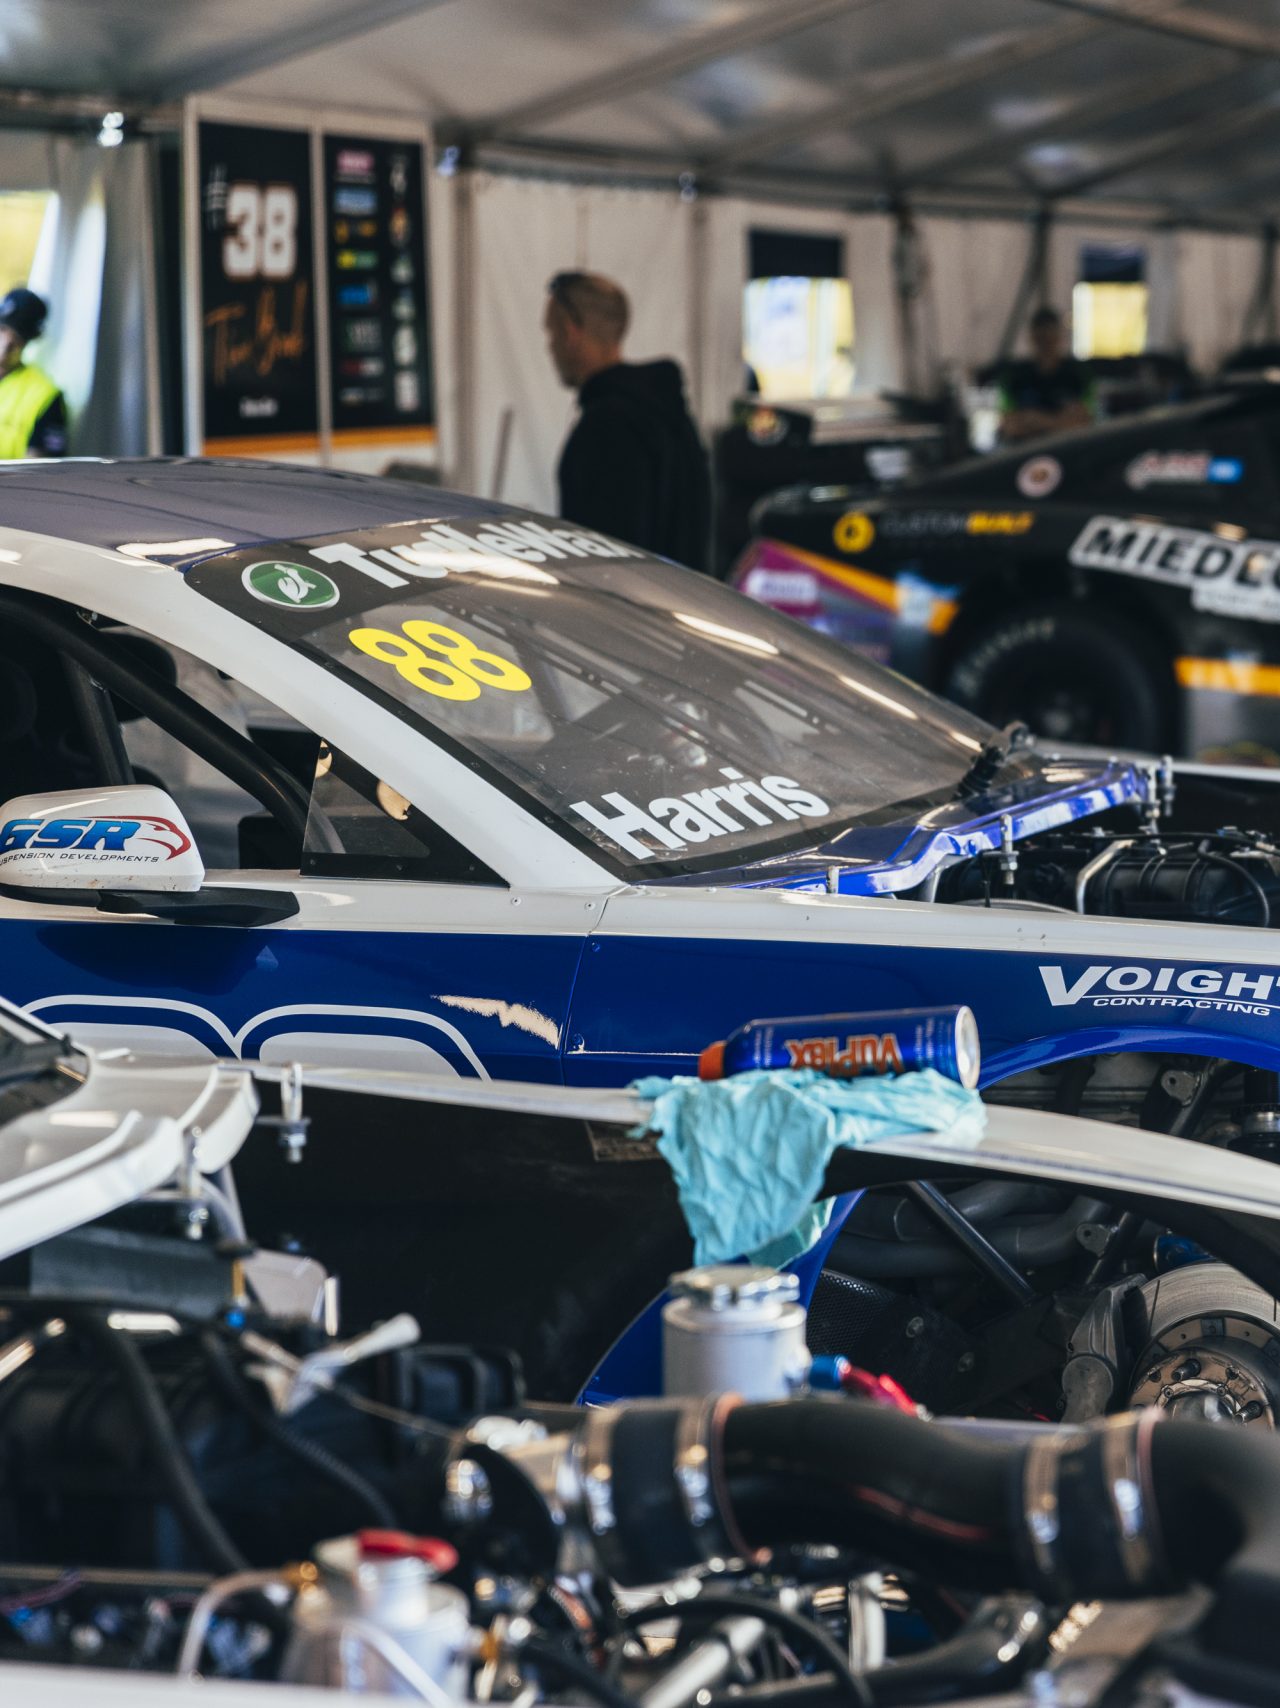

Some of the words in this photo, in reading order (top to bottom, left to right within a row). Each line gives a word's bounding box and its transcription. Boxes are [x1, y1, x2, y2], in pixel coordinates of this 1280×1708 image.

[223, 182, 297, 279] 38
[349, 619, 532, 702] 88
[0, 818, 141, 854] GSR
[569, 766, 830, 860] Harris
[60, 853, 159, 863] DEVELOPMENTS
[1093, 997, 1270, 1017] CONTRACTING
